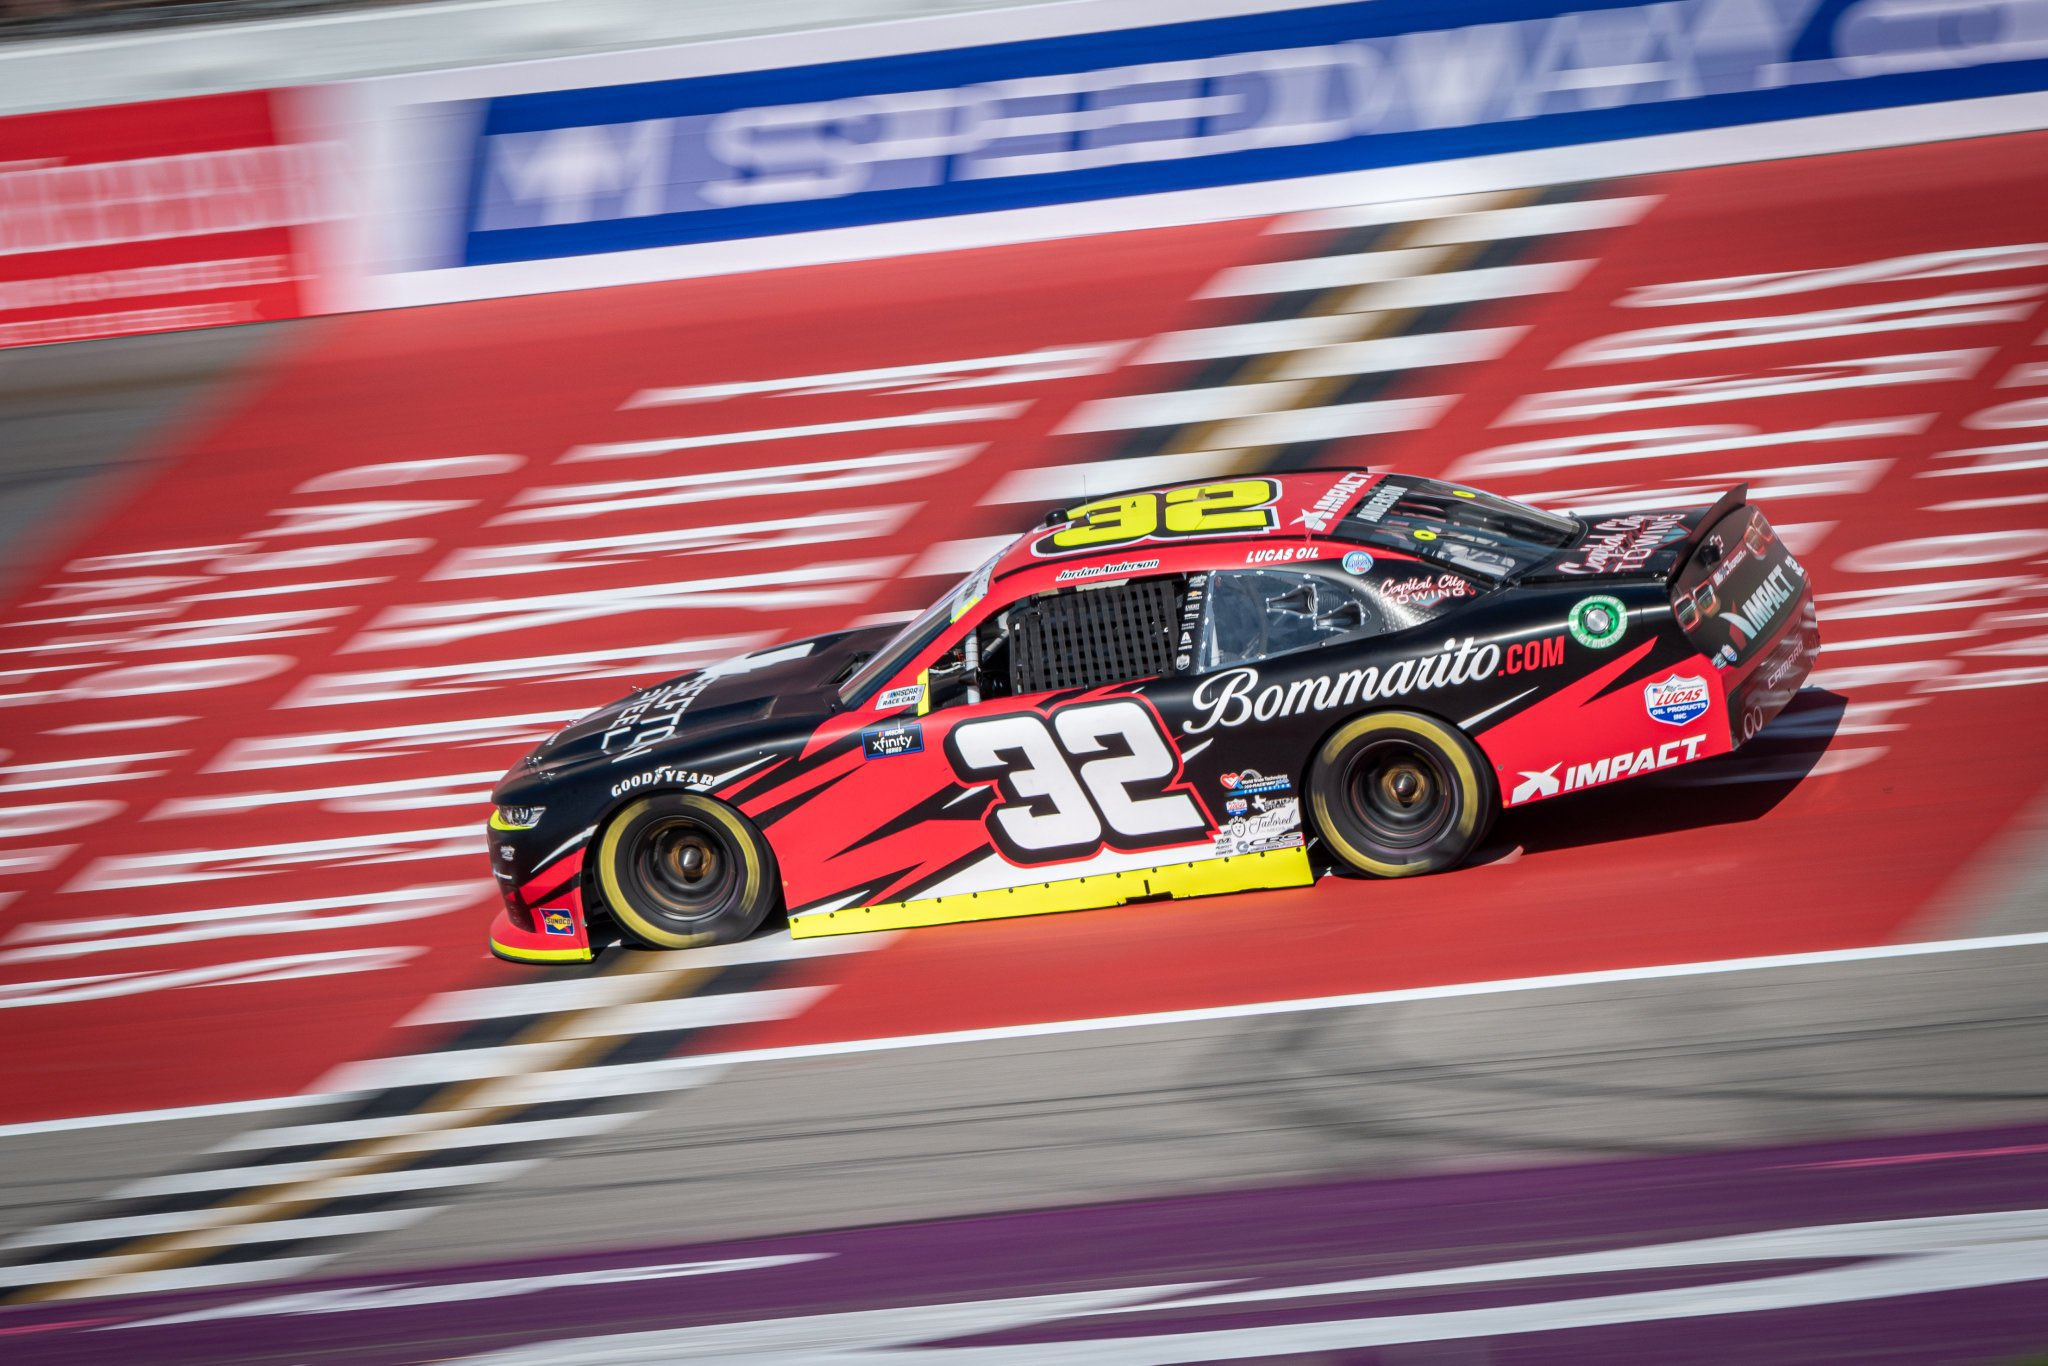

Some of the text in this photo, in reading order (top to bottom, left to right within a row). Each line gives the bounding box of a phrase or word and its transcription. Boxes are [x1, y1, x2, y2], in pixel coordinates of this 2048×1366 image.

[1313, 472, 1374, 514] IMPACT
[1053, 480, 1269, 547] 32
[1246, 547, 1319, 563] LUCAS OIL
[1056, 559, 1159, 582] Jordan Anderson
[1380, 574, 1465, 598] Capital City
[1741, 564, 1795, 632] IMPACT
[1767, 638, 1804, 690] CAMARO
[882, 695, 916, 706] RACE CAR
[890, 687, 918, 699] NASCAR
[1655, 688, 1703, 706] LUCAS
[1666, 702, 1706, 714] PRODUCTS
[872, 734, 913, 752] xfinity
[1563, 733, 1707, 791] IMPACT
[954, 702, 1205, 849] 32
[546, 916, 572, 926] SUNOCO
